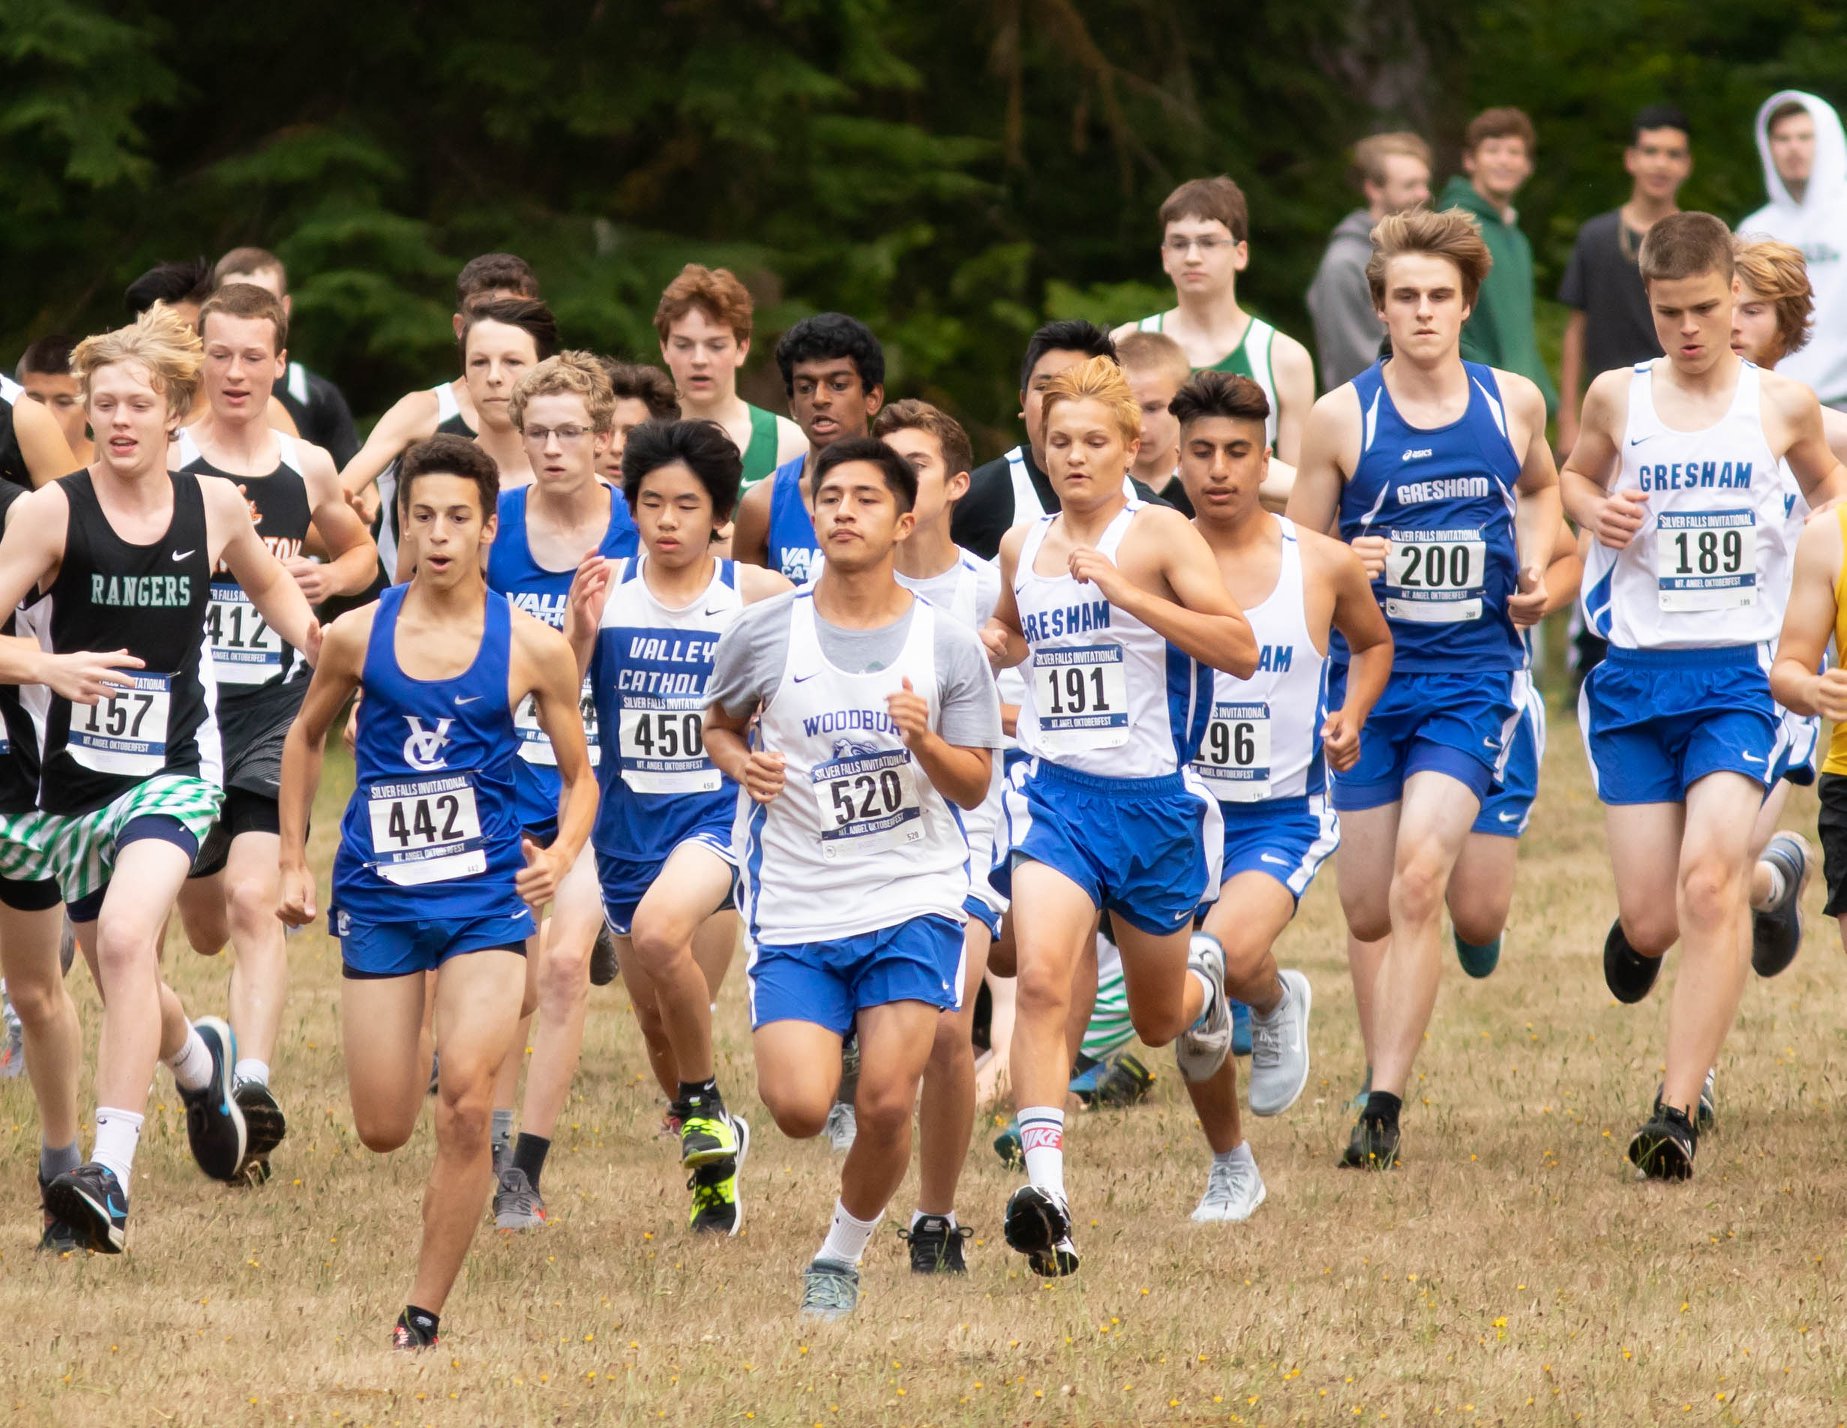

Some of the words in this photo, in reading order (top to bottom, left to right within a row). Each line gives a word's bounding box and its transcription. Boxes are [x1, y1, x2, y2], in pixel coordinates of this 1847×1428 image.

[1397, 477, 1489, 505] GRESHAM
[1640, 461, 1753, 492] GRESHAM
[1391, 529, 1415, 541] SILVER
[1415, 529, 1435, 541] FALLS
[1435, 528, 1481, 541] INVITATIONAL
[1661, 516, 1685, 528] SILVER
[1686, 515, 1707, 527] FALLS
[1708, 513, 1752, 527] INVITATIONAL
[1401, 545, 1470, 587] 200
[1675, 530, 1742, 574] 189
[91, 573, 191, 607] RANGERS
[218, 590, 238, 602] FALLS
[206, 604, 268, 648] 412
[1022, 600, 1111, 643] GRESHAM
[629, 637, 718, 663] VALLEY
[1036, 653, 1055, 665] SILVER
[1055, 652, 1072, 665] FALLS
[1073, 649, 1119, 664] INVITATIONAL
[624, 697, 646, 709] SILVER
[648, 698, 665, 709] FALLS
[1049, 667, 1109, 714] 191
[85, 692, 154, 738] 157
[1219, 707, 1266, 718] INVITATIONAL
[634, 713, 704, 757] 450
[1194, 722, 1255, 765] 96
[814, 765, 840, 781] SILVER
[841, 761, 860, 774] FALLS
[860, 754, 907, 772] INVITATIONAL
[371, 785, 396, 799] SILVER
[396, 783, 418, 796] FALLS
[418, 776, 468, 795] INVITATIONAL
[830, 770, 901, 825] 520
[388, 795, 464, 847] 442
[907, 831, 919, 840] 520
